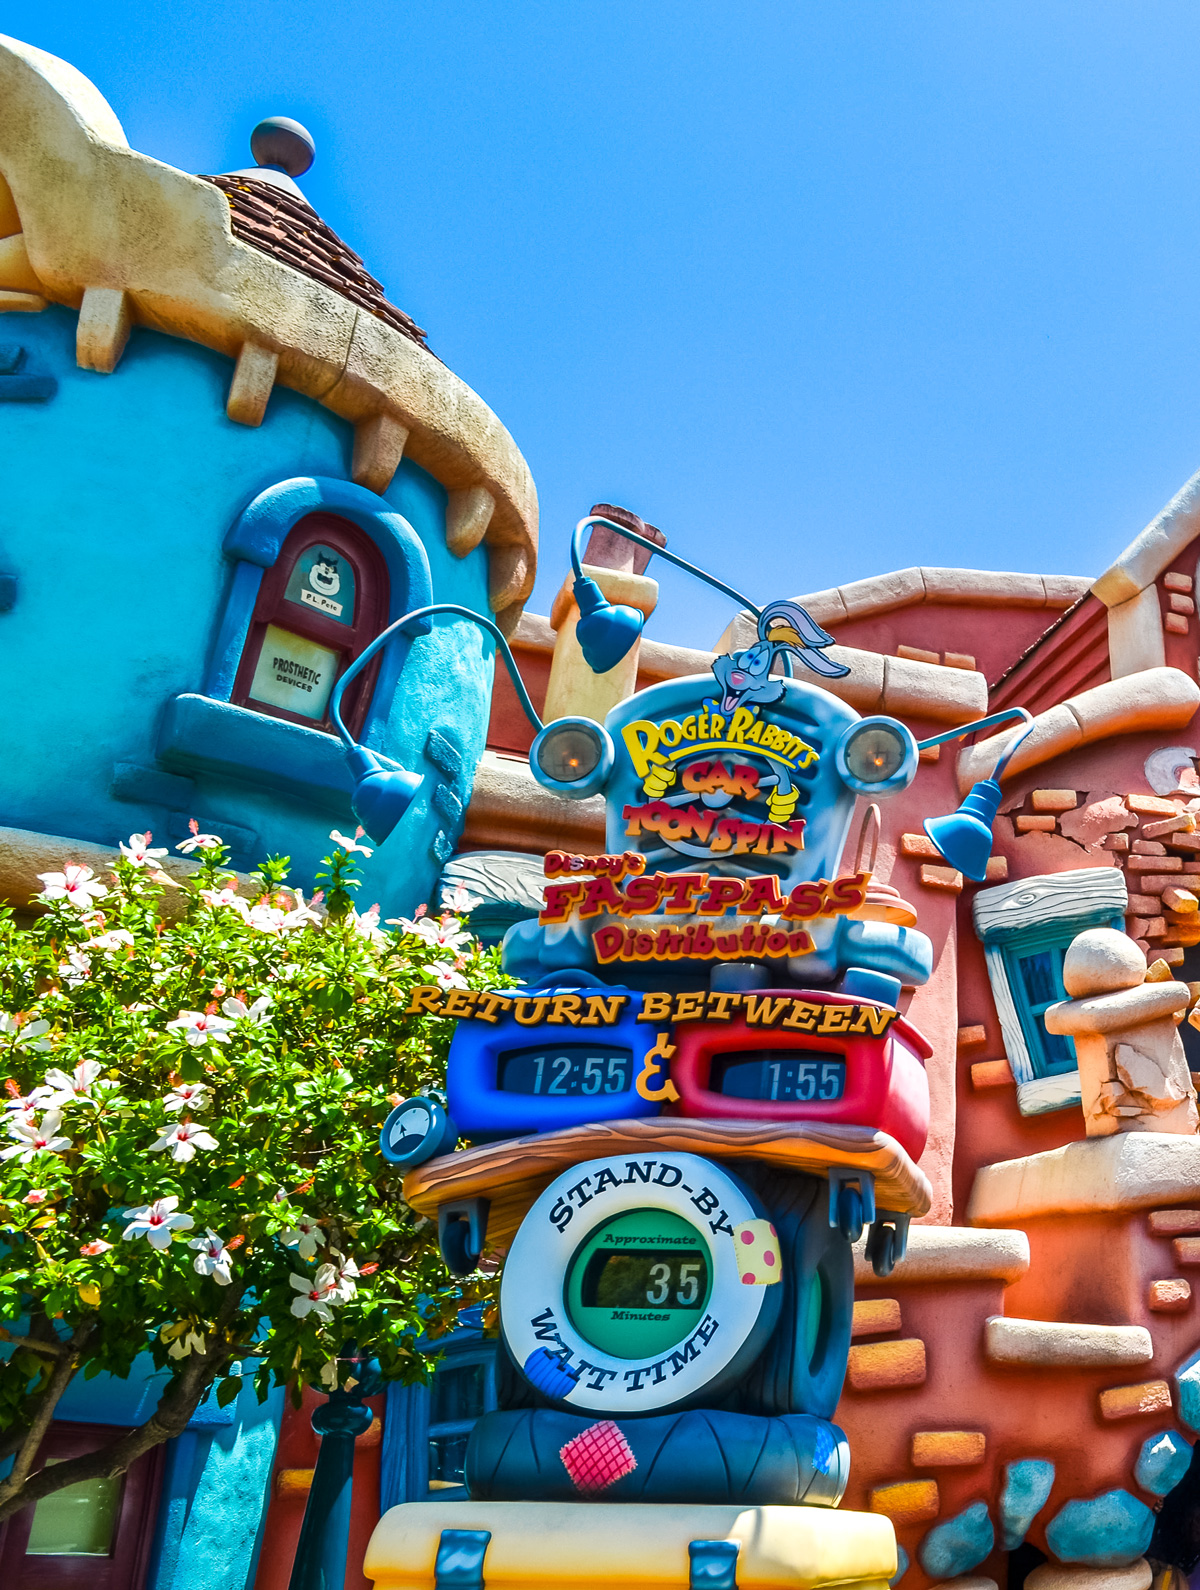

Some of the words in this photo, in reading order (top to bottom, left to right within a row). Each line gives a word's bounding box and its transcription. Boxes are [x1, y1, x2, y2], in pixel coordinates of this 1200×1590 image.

[272, 657, 321, 685] PROSTHETIC
[276, 674, 313, 693] DEVICES
[621, 709, 726, 779] ROGER
[726, 706, 820, 769] RABBIT'S
[682, 760, 761, 800] CAR
[622, 801, 719, 843] TOON
[710, 819, 807, 855] SPIN
[544, 850, 645, 878] Disney's
[540, 871, 871, 924] FASTPASS
[593, 922, 813, 961] Distribution
[405, 986, 626, 1025] RETURN
[636, 991, 898, 1036] BETWEEN
[533, 1057, 627, 1095] 12:55
[635, 1032, 680, 1102] &
[769, 1063, 841, 1100] 1:55
[549, 1160, 734, 1237] STAND-BY
[603, 1234, 697, 1246] Approximate
[646, 1263, 701, 1305] 35
[610, 1311, 671, 1322] Minutes
[530, 1307, 618, 1391] WAIT
[623, 1313, 720, 1392] TIME
